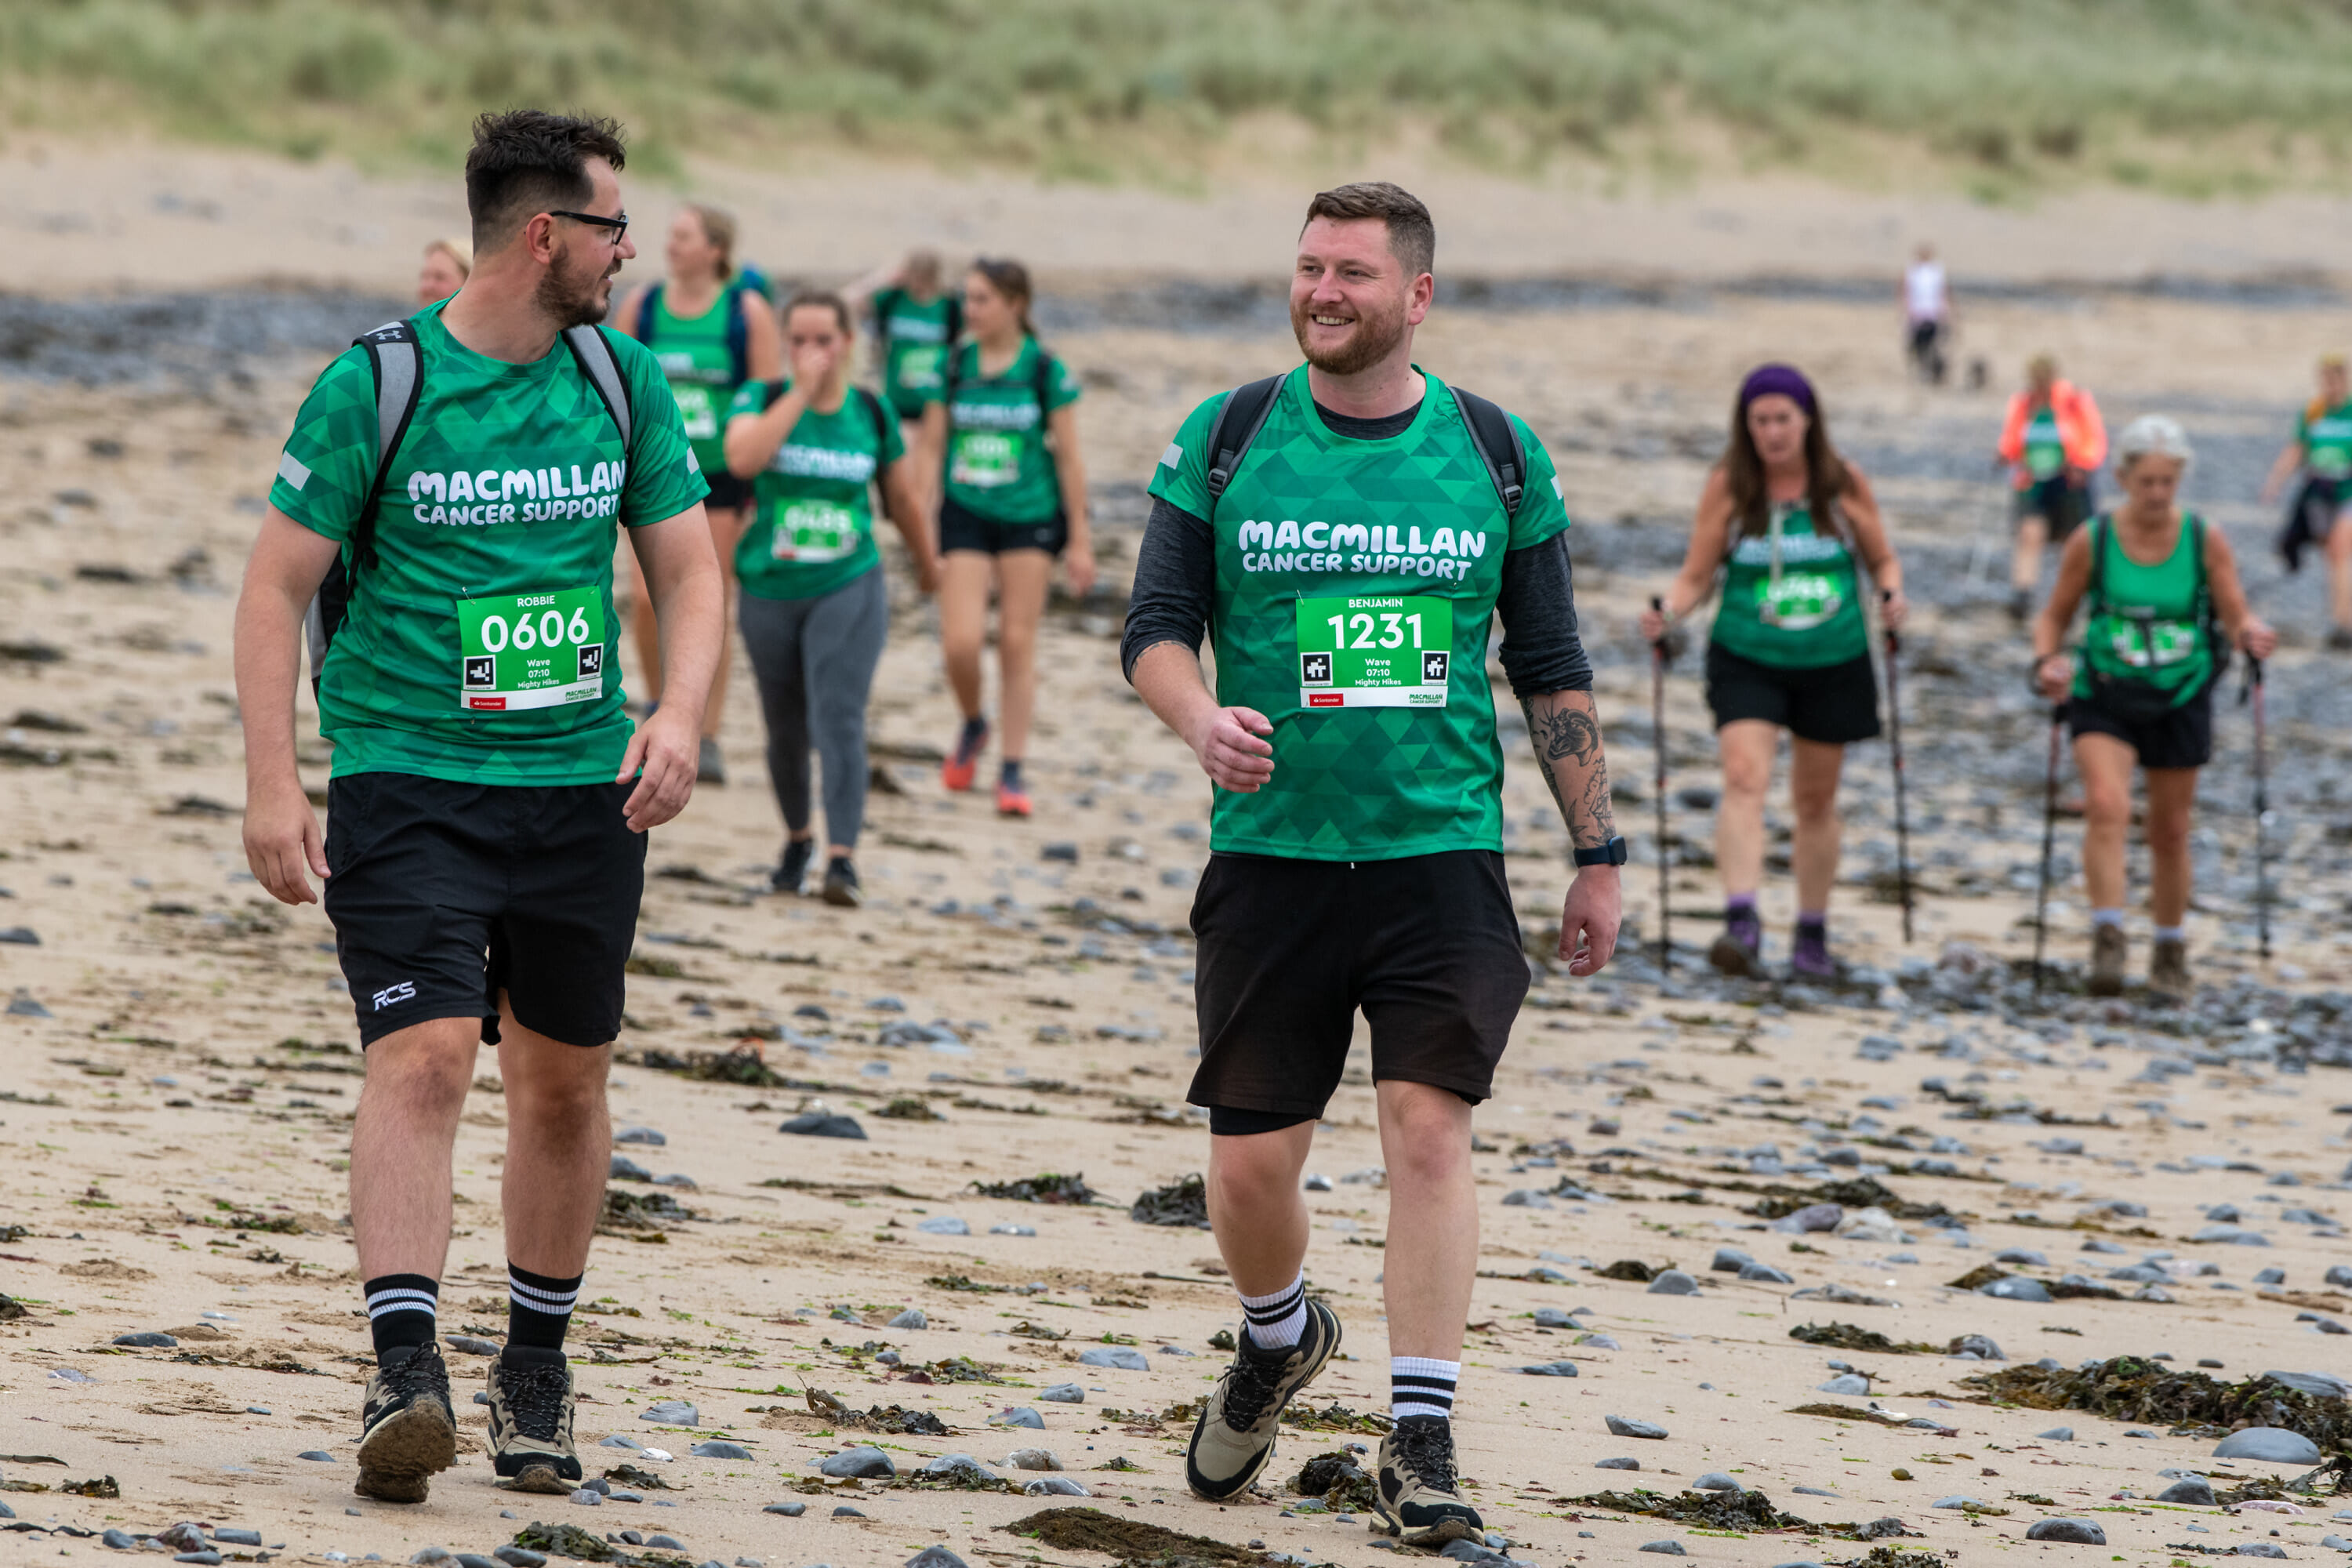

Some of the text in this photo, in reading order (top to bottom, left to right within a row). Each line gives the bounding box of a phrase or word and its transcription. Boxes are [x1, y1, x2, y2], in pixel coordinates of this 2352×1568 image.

[408, 459, 626, 503] MACMILLAN
[413, 494, 619, 526] CANCER SUPPORT
[1238, 519, 1486, 557] MACMILLAN
[1243, 552, 1472, 581] CANCER SUPPORT
[517, 595, 556, 607] ROBBIE
[1348, 598, 1403, 608] BENJAMIN
[481, 607, 590, 653] 0606
[1327, 613, 1421, 649] 1231
[528, 669, 550, 678] 07:10
[1365, 658, 1391, 666] Wave
[517, 681, 541, 689] Mighty
[372, 981, 416, 1012] RCS
